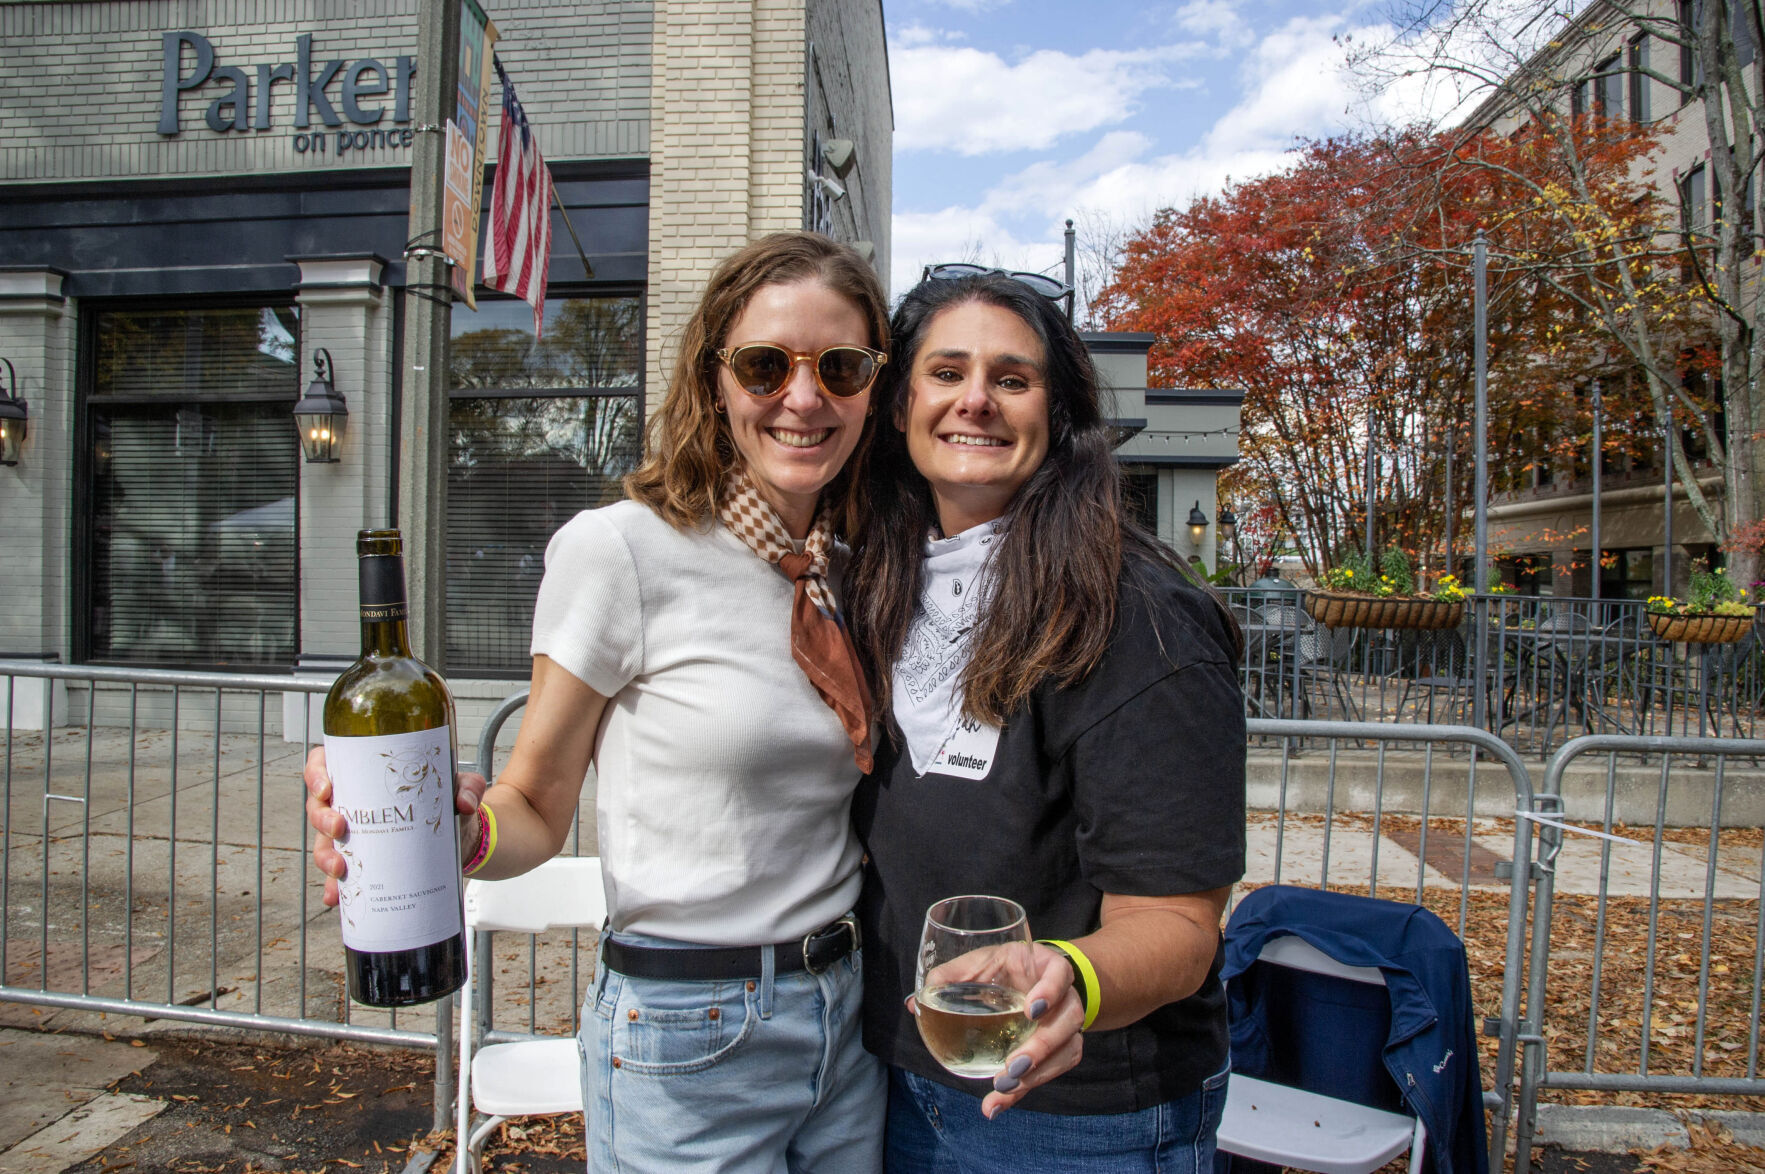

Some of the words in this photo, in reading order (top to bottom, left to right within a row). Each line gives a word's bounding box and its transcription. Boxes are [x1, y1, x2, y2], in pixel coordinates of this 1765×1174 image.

[157, 31, 417, 135] Parker
[293, 132, 326, 153] on
[336, 127, 413, 156] ponce
[451, 127, 470, 174] NO
[472, 87, 489, 233] DOWNTOWN
[947, 752, 988, 771] volunteer
[370, 893, 407, 902] CABERNET
[371, 904, 388, 913] NAPA
[390, 902, 417, 912] VALLEY
